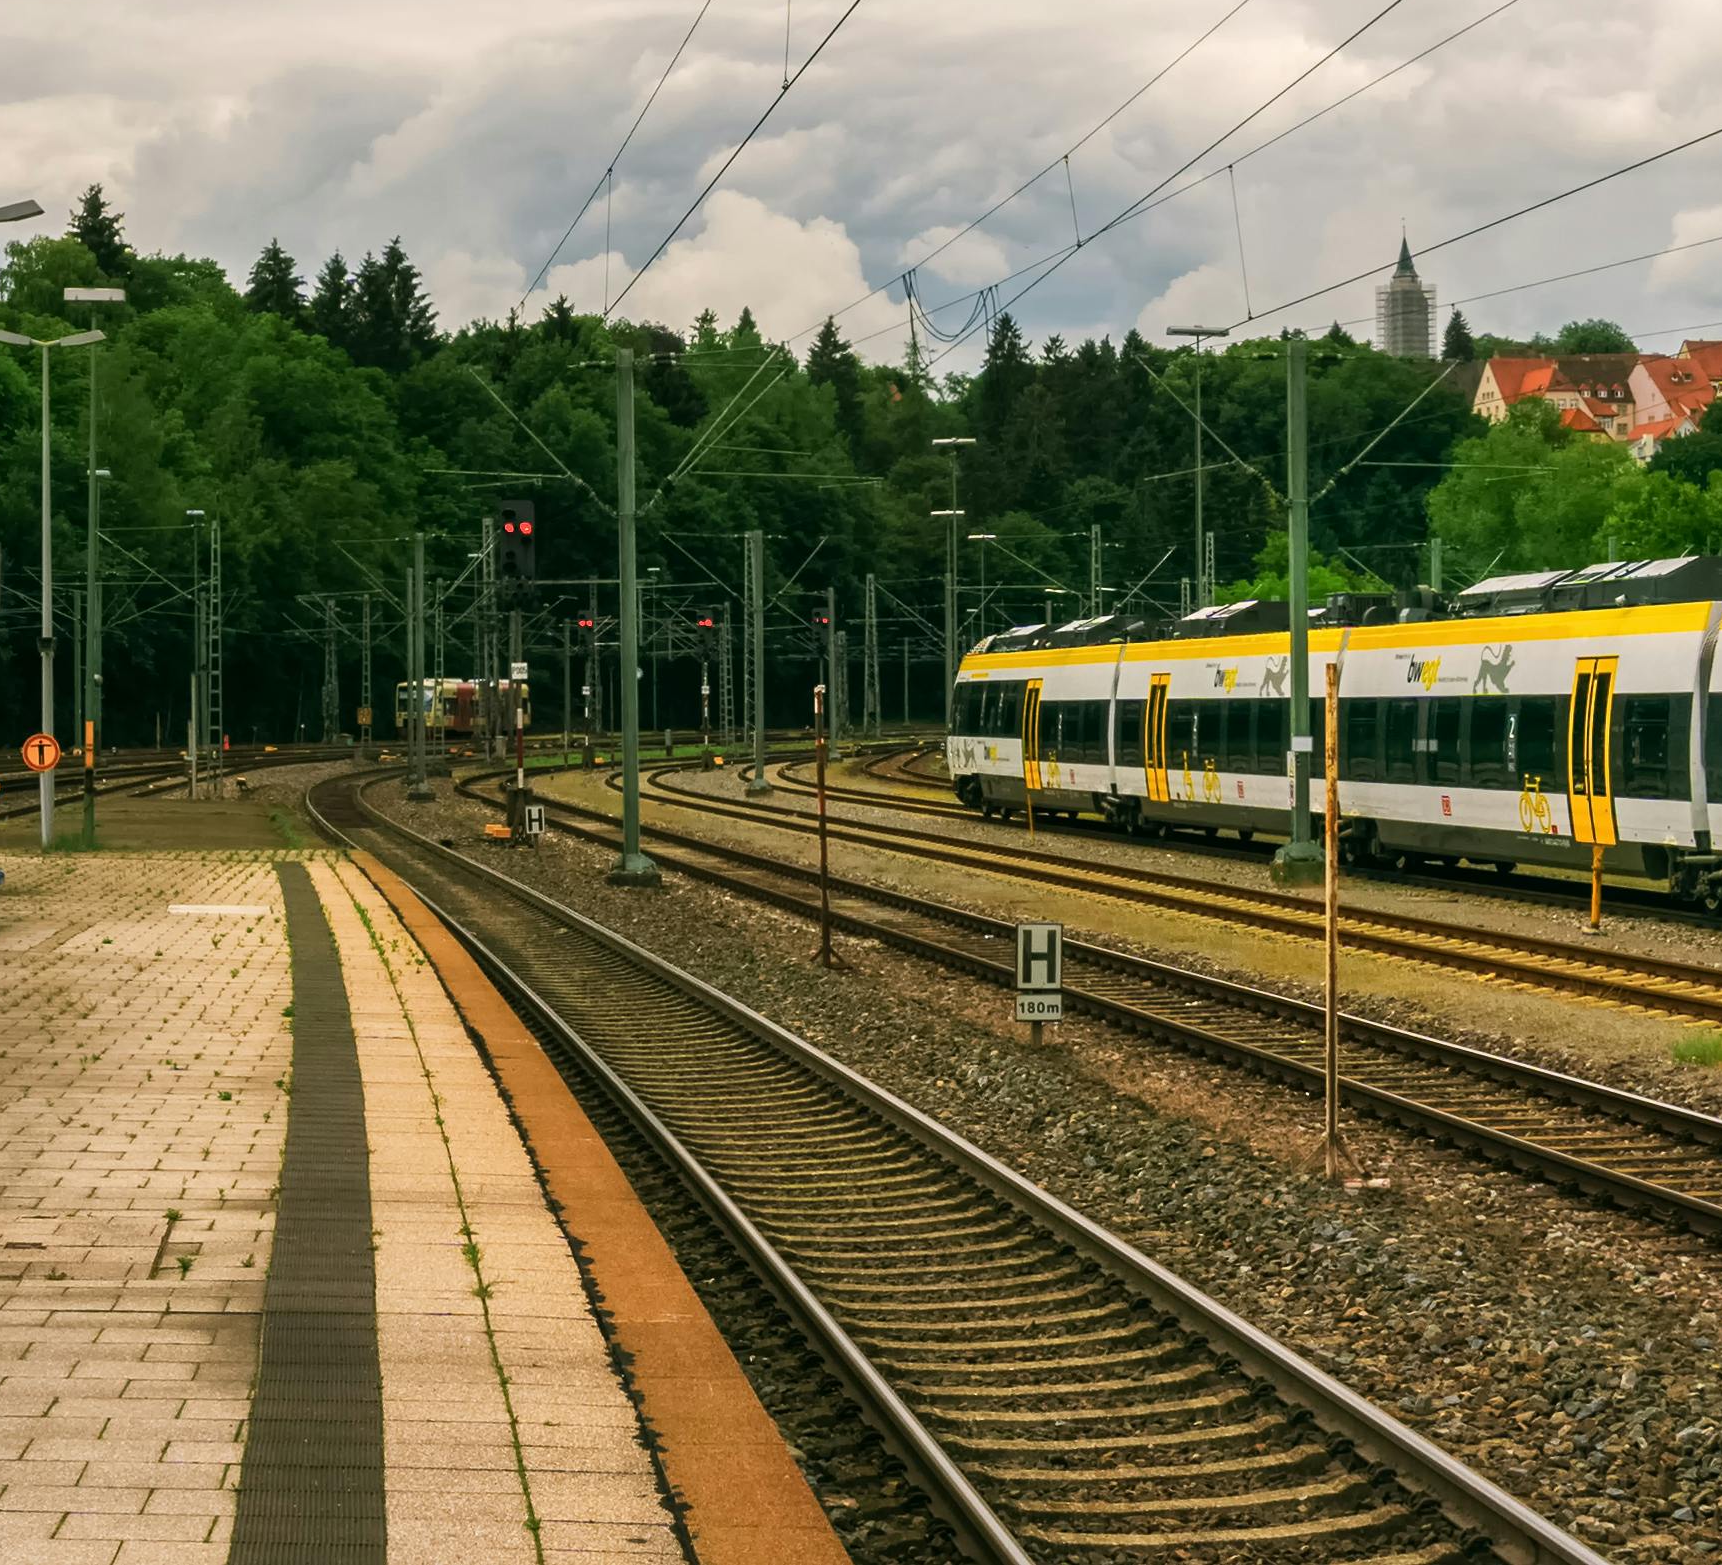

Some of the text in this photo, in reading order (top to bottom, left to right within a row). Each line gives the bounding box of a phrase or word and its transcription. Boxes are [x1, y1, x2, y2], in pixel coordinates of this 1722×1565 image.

[527, 808, 543, 832] H
[1022, 929, 1056, 984] H
[1019, 1001, 1059, 1014] 180m
